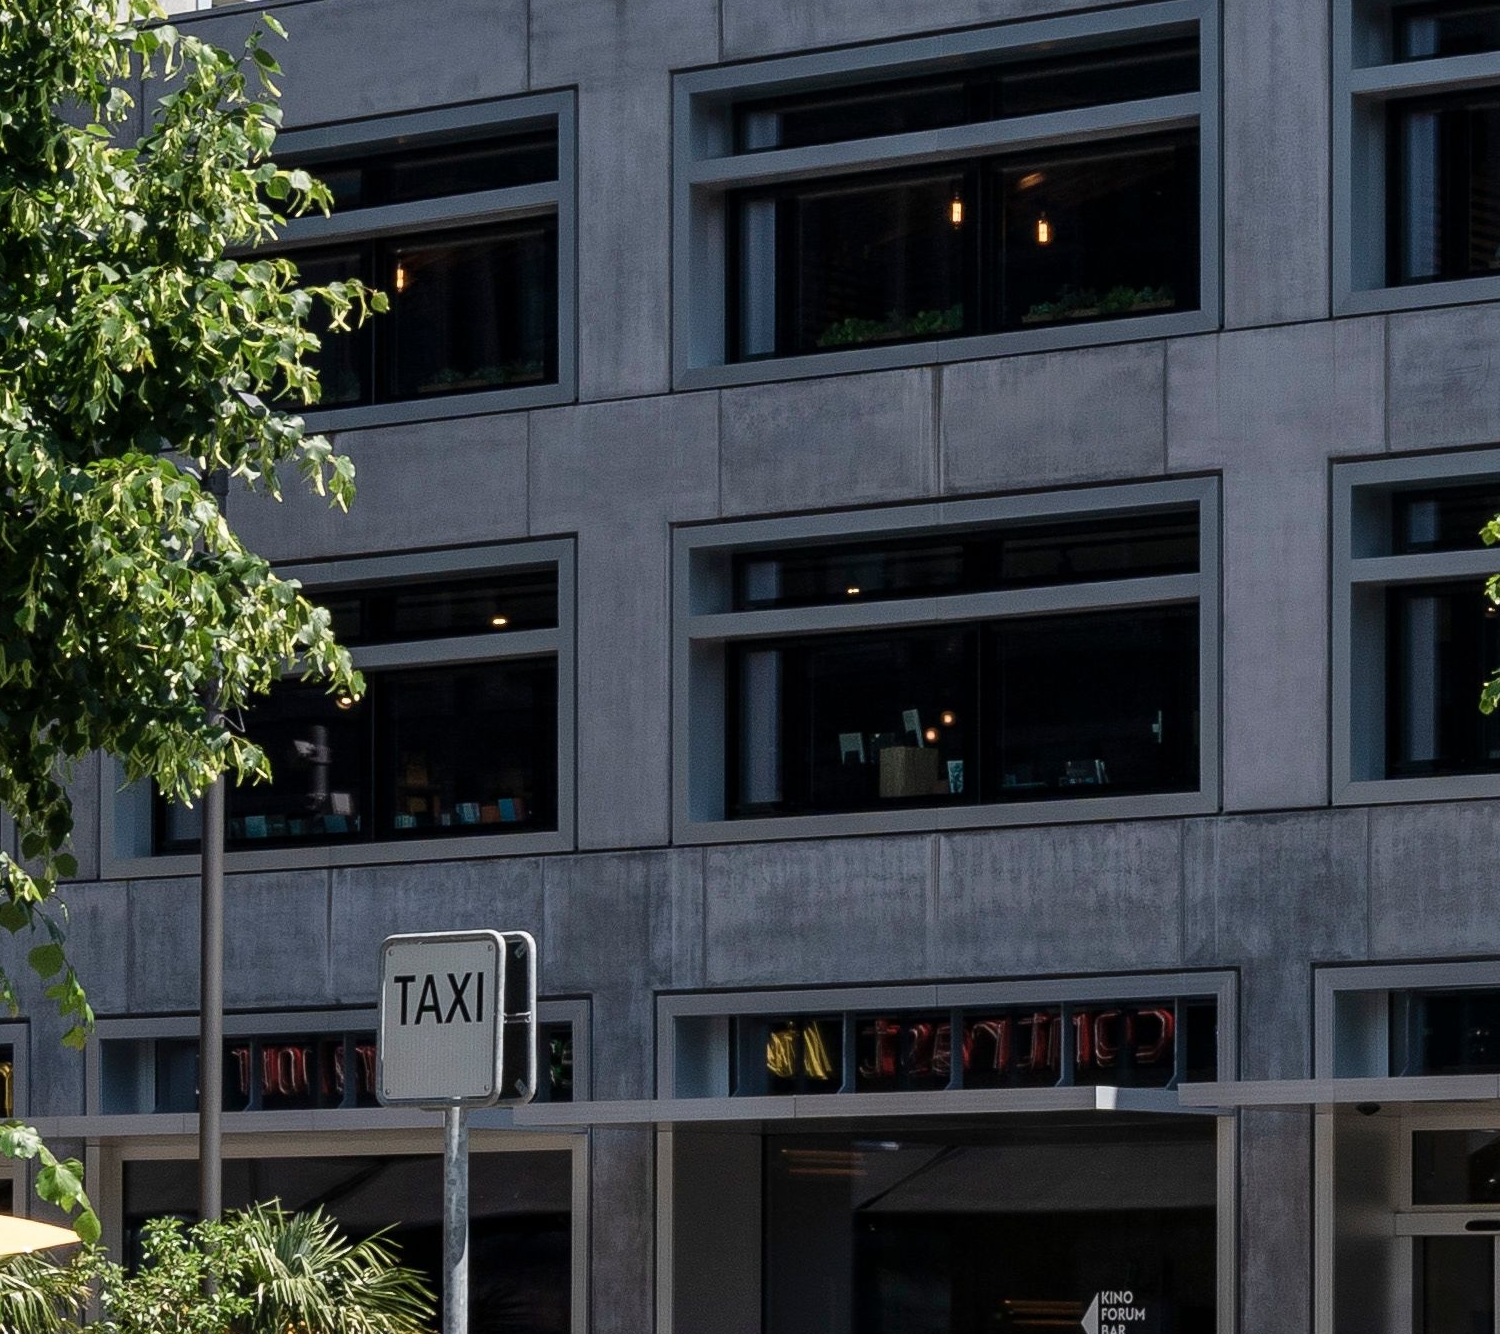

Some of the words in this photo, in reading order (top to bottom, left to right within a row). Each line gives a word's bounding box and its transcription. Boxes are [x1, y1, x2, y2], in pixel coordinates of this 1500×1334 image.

[394, 971, 484, 1026] TAXI
[1101, 1290, 1133, 1304] KINO
[1101, 1307, 1146, 1321] FORUM
